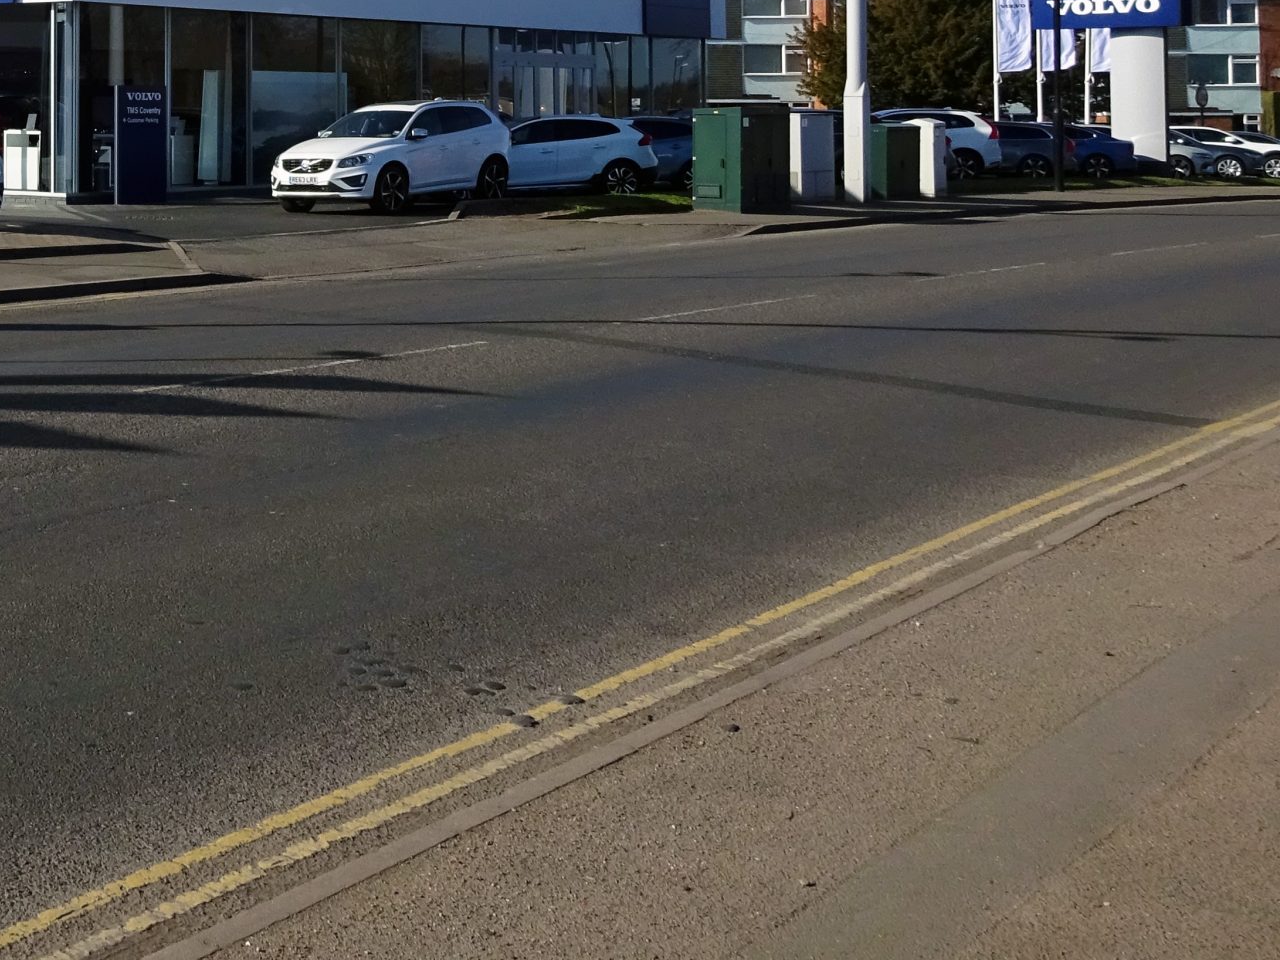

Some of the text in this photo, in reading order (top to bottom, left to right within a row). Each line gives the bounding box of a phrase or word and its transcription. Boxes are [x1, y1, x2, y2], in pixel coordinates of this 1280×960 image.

[126, 92, 161, 101] VOLVO
[127, 106, 161, 115] TMS Coventry
